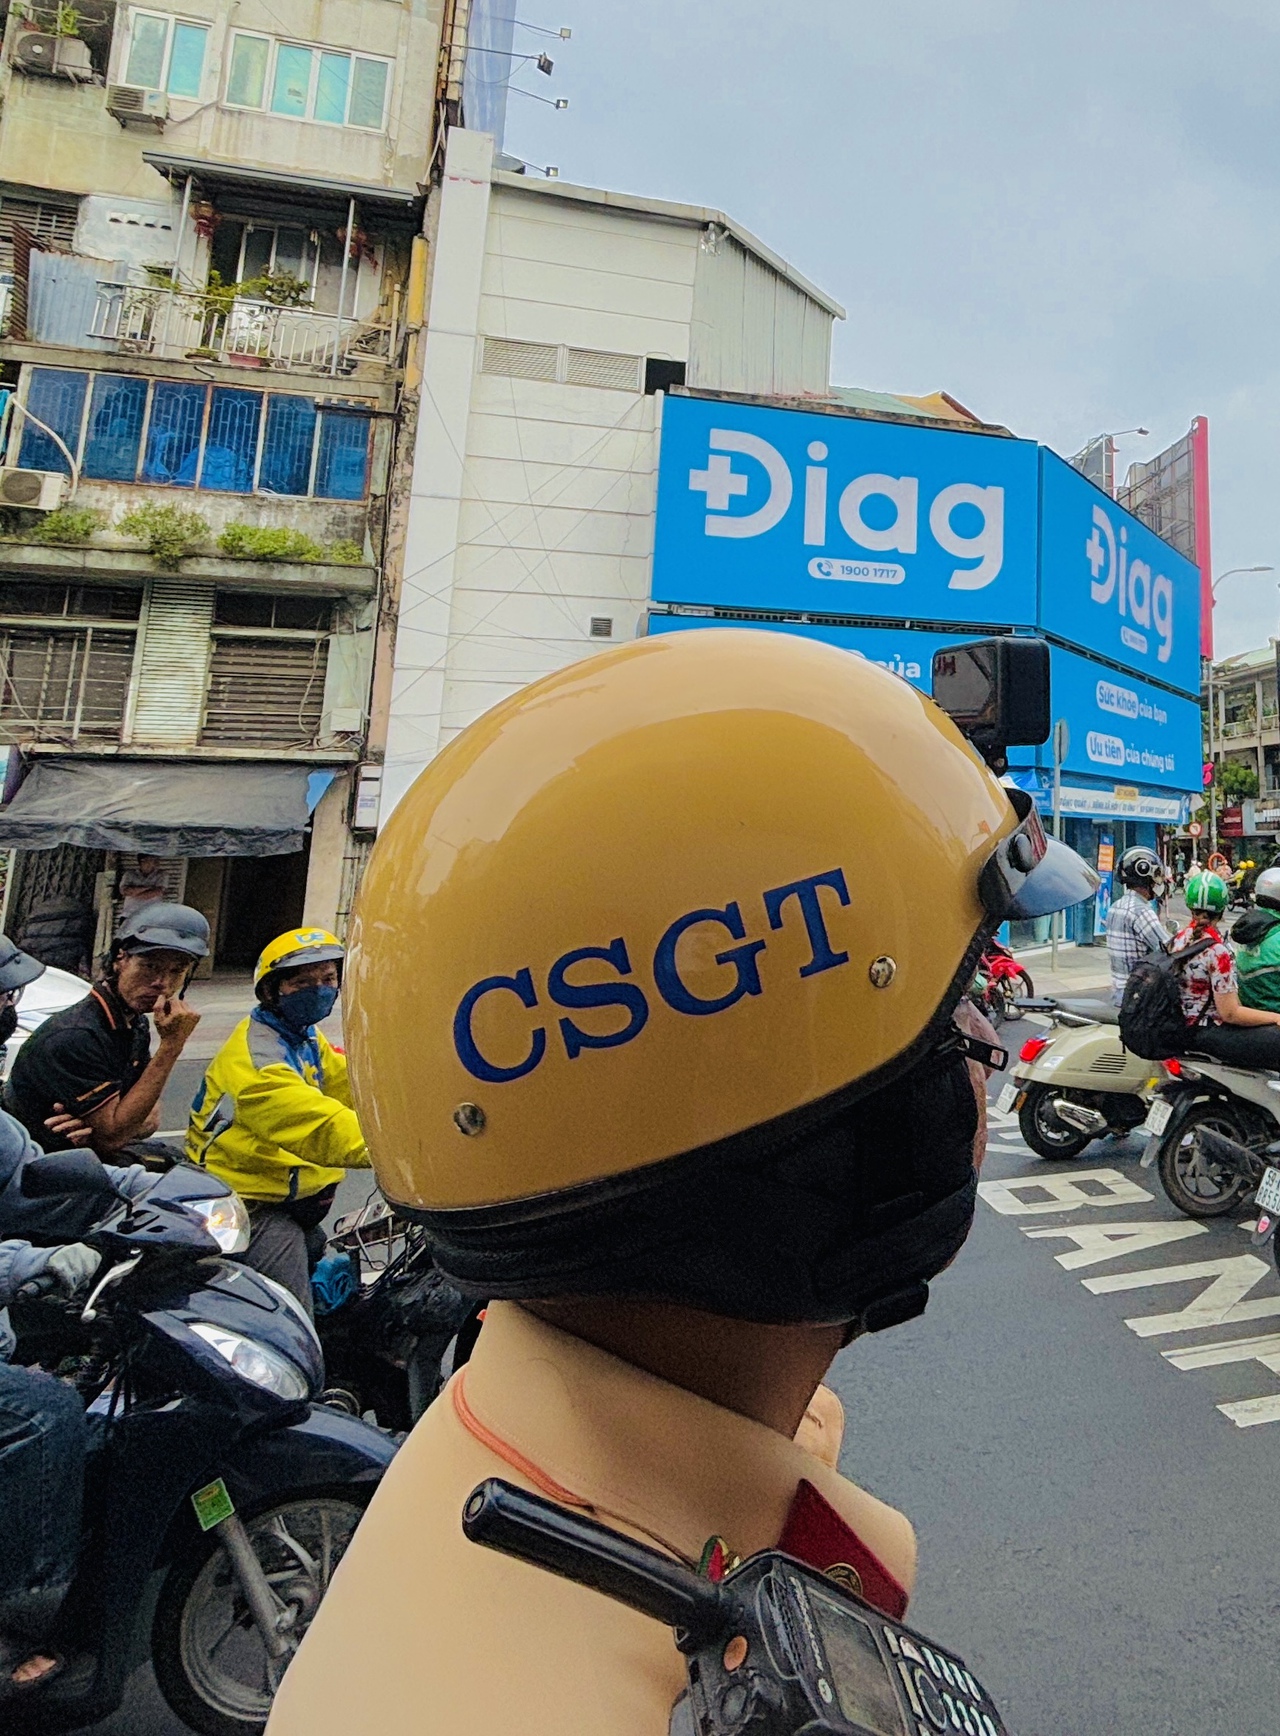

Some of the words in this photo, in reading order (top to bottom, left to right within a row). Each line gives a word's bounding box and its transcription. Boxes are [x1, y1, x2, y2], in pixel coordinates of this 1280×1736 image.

[840, 565, 870, 578] 1900
[873, 567, 898, 579] 1717
[1099, 685, 1115, 706] Sức
[1139, 698, 1153, 719] của
[1153, 704, 1168, 726] bạn
[1126, 743, 1140, 764] của
[1141, 749, 1165, 773] chúng
[453, 867, 851, 1083] CSGT
